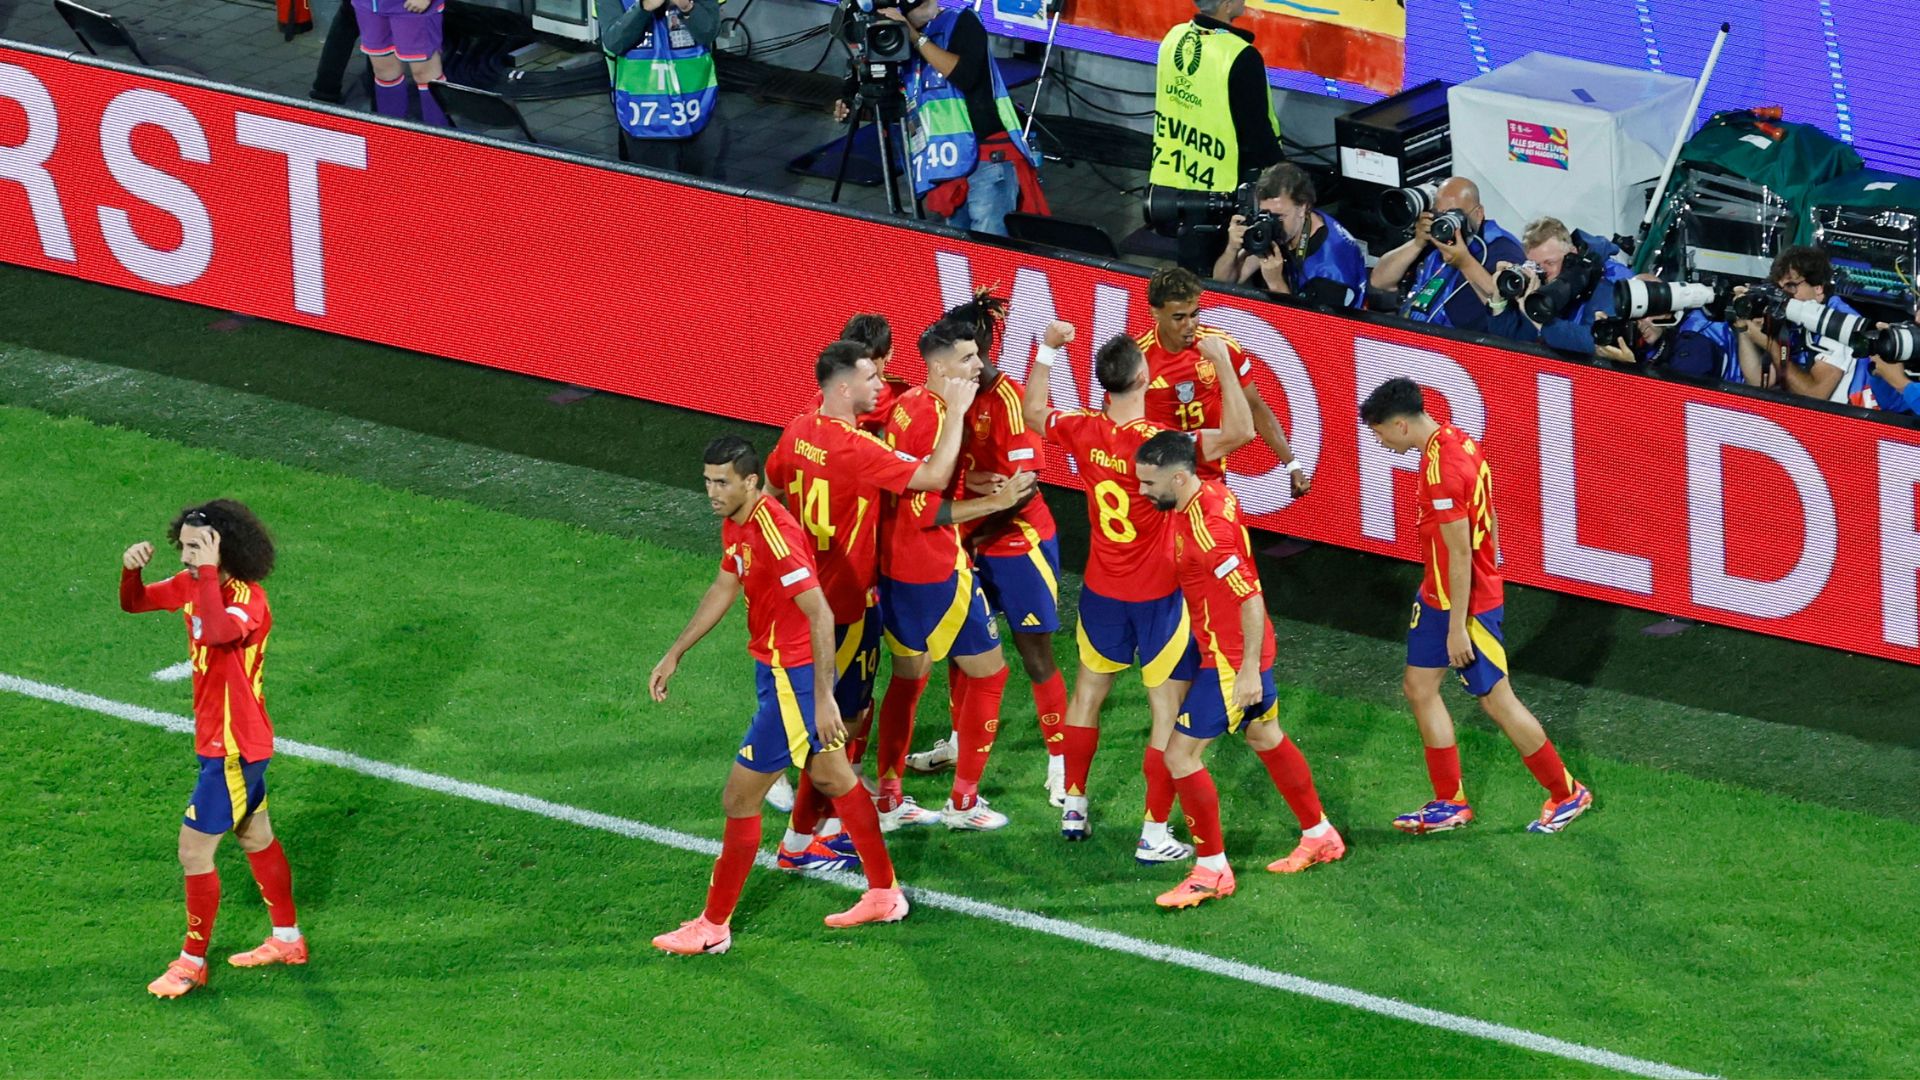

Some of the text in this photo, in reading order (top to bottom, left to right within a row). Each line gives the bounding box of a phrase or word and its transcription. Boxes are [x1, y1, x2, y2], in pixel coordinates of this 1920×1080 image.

[1175, 401, 1205, 431] 19
[789, 469, 836, 551] 14
[1094, 480, 1137, 543] 8
